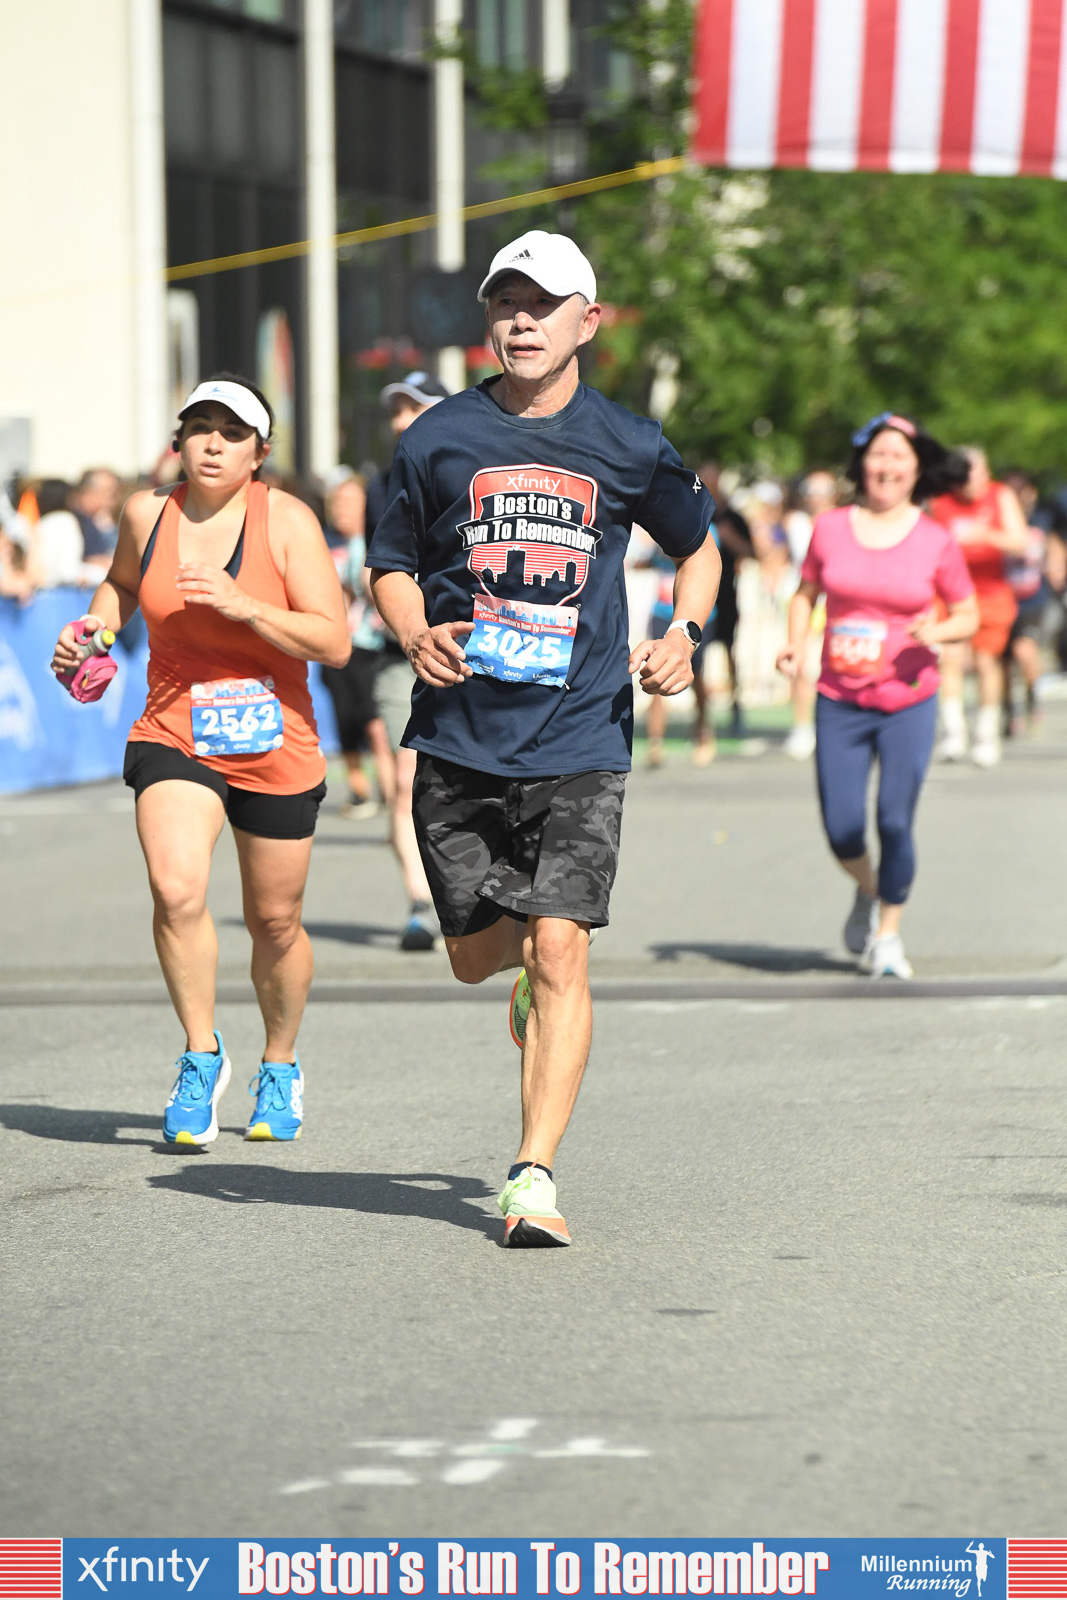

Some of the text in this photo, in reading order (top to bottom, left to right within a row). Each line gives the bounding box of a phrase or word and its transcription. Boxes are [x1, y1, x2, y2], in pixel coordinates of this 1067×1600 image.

[506, 474, 561, 493] xfinity
[493, 494, 573, 520] Boston's
[463, 518, 595, 553] Run To Remember
[532, 624, 540, 633] To
[477, 624, 562, 667] 3025
[201, 703, 278, 736] 2562
